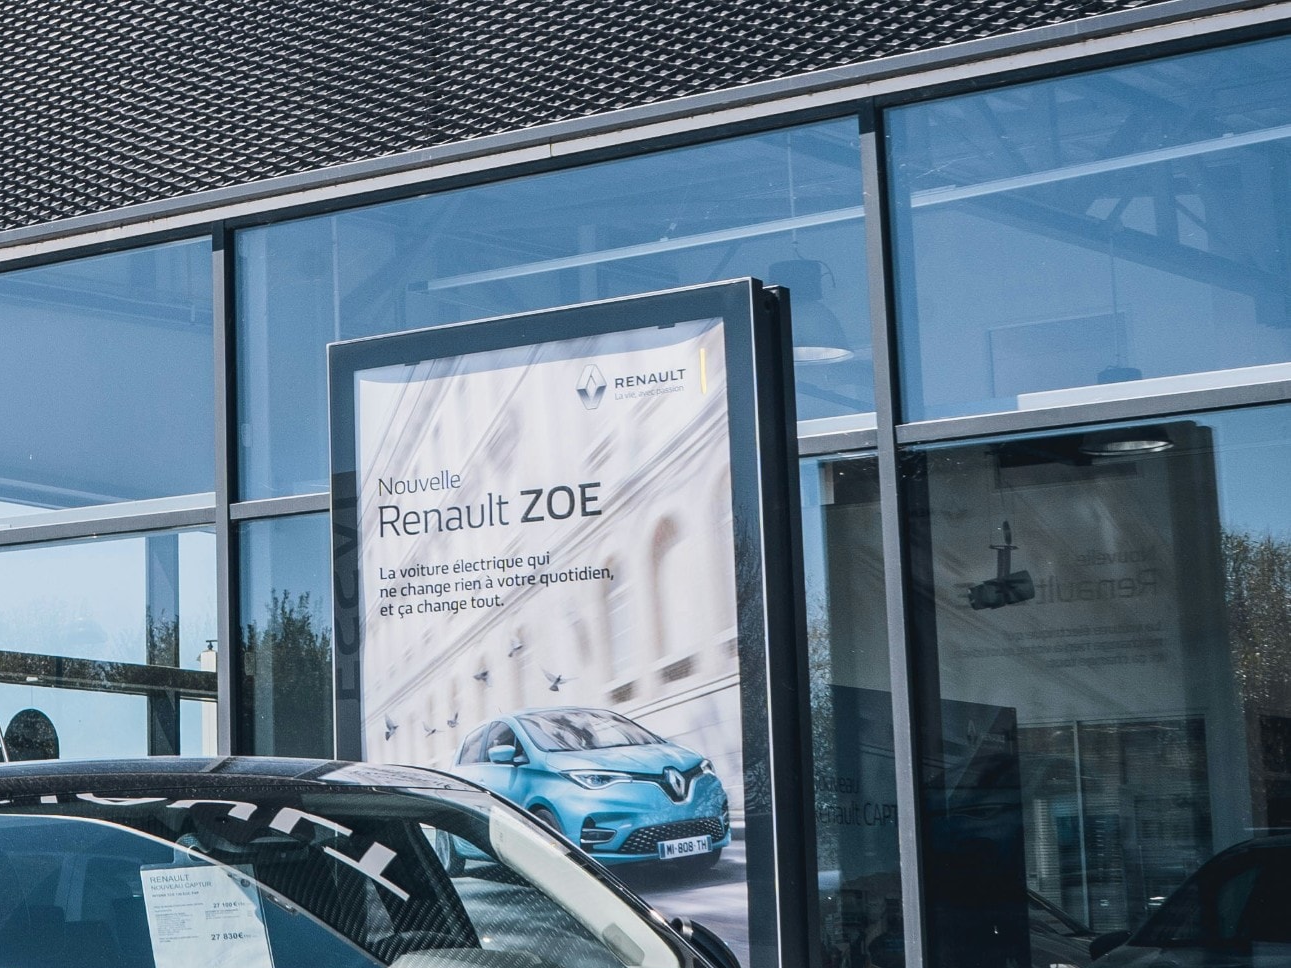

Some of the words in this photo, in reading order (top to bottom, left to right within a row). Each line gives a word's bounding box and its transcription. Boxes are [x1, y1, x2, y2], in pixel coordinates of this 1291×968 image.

[614, 367, 687, 389] RENAULT
[378, 470, 462, 497] Nouvelle
[378, 493, 510, 538] Renault
[520, 482, 603, 524] ZOE
[379, 567, 397, 580] La
[400, 560, 450, 577] voiture
[452, 554, 524, 575] électrique
[527, 551, 551, 571] qui
[379, 586, 397, 599] ne
[400, 579, 452, 600] change
[454, 575, 482, 592] rien
[485, 573, 494, 590] à
[497, 571, 536, 588] votre
[539, 565, 615, 586] quotidien,
[379, 603, 394, 617] et
[398, 602, 413, 620] ça
[417, 596, 467, 615] change
[470, 593, 505, 611] tout.
[150, 874, 190, 884] RENAULT
[150, 883, 184, 891] NOUVEAU
[185, 881, 213, 889] CAPTUR
[211, 933, 221, 941] 27
